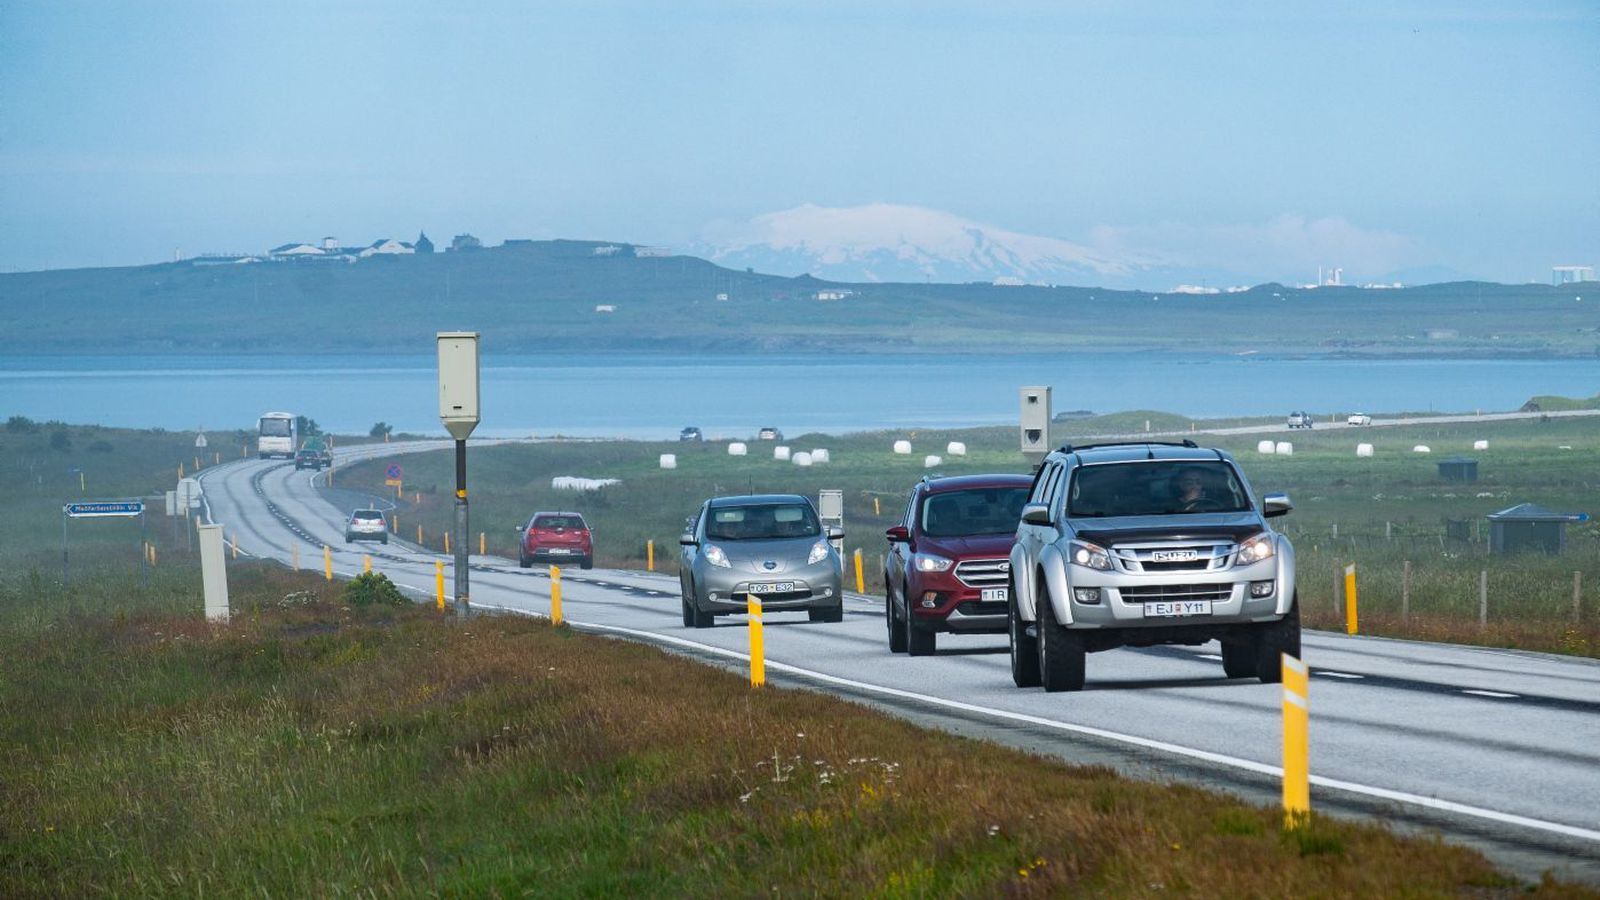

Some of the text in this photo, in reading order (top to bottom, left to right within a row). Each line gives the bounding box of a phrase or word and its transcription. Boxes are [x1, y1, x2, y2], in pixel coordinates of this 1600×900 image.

[1154, 551, 1197, 561] ISUZU
[1156, 603, 1173, 614] EJ
[1184, 602, 1204, 613] Y11
